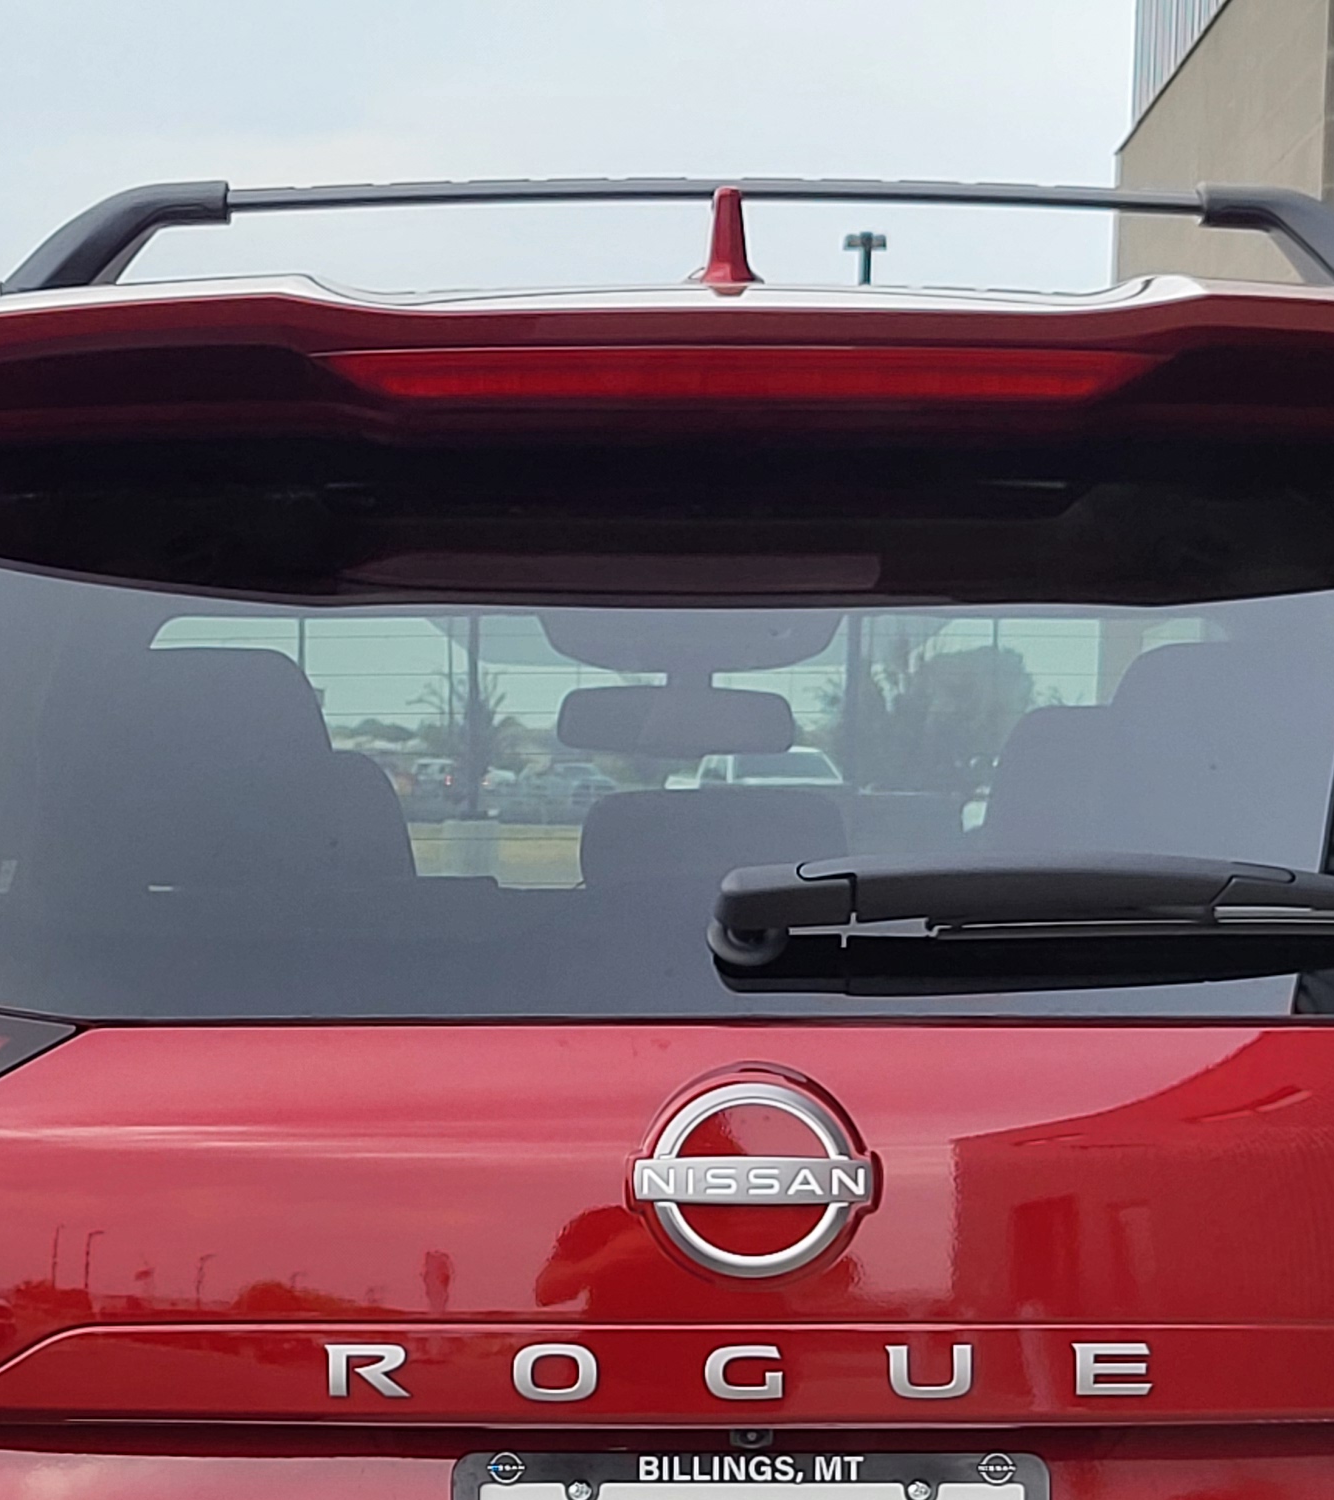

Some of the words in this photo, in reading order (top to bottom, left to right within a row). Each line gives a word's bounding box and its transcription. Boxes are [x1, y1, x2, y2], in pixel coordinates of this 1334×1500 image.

[640, 1166, 868, 1197] NISSAN
[323, 1342, 1155, 1401] ROGUE
[638, 1455, 804, 1483] BILLINGS,
[814, 1456, 865, 1481] MT
